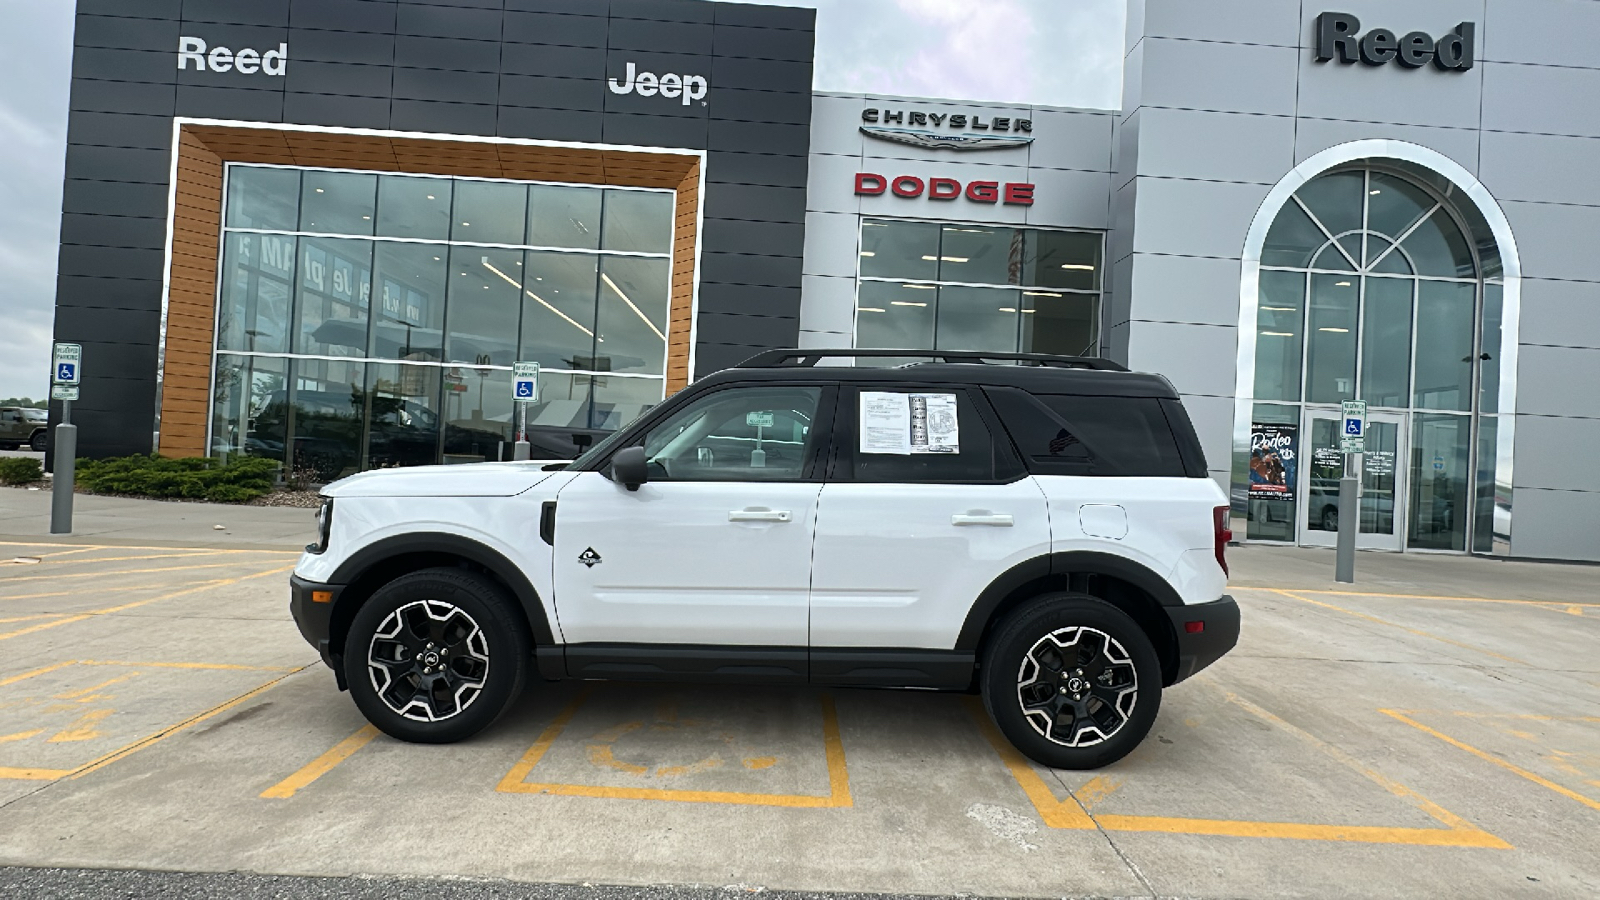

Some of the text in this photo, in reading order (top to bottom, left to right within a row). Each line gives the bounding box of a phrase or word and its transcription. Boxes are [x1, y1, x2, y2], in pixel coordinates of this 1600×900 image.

[177, 36, 288, 76] Reed
[1316, 11, 1476, 72] Reed
[607, 61, 708, 106] Jeep
[861, 108, 1033, 132] CHRYSLER
[854, 172, 1036, 207] DODGE
[514, 371, 537, 379] PARKING
[515, 364, 537, 372] RESERVED
[1251, 431, 1292, 453] Rodeo
